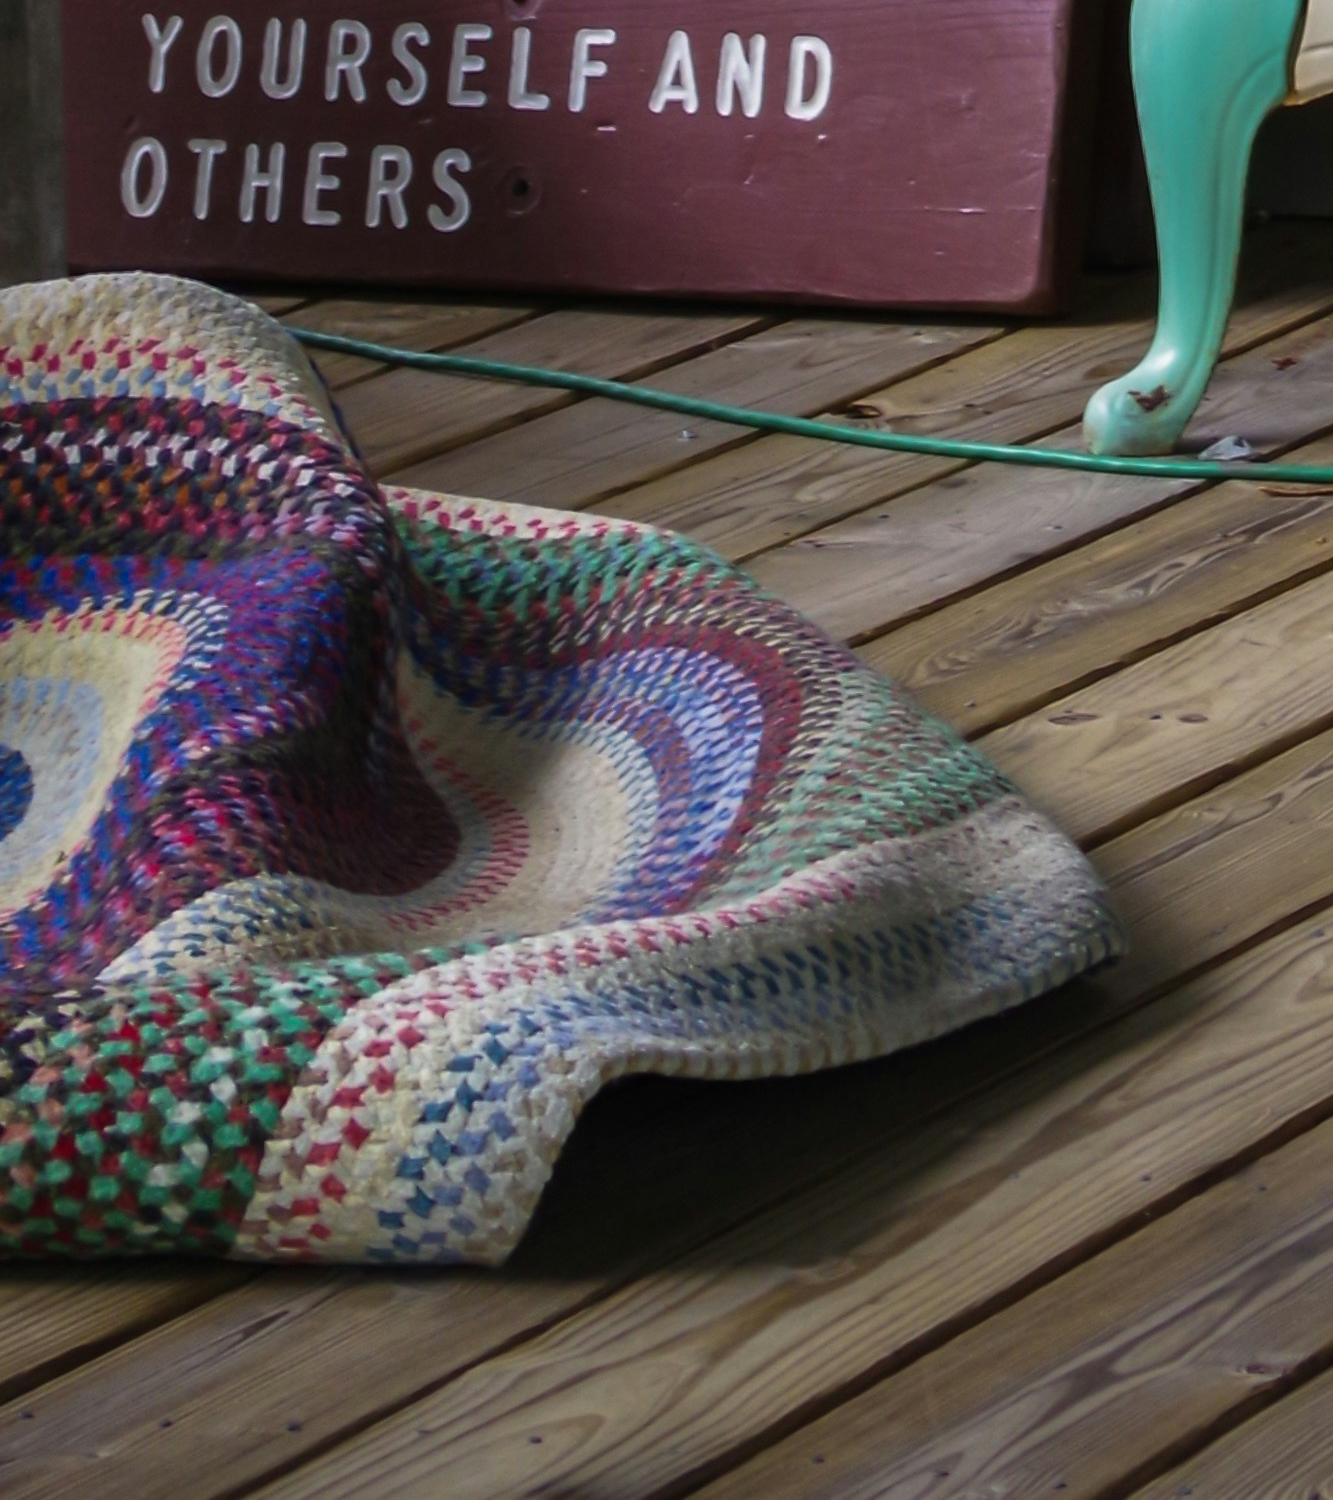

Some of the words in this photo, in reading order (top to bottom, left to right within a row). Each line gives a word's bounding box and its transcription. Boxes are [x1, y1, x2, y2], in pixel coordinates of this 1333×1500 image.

[141, 12, 615, 112] YOURSELF
[648, 30, 833, 121] AND
[119, 136, 473, 233] OTHERS
